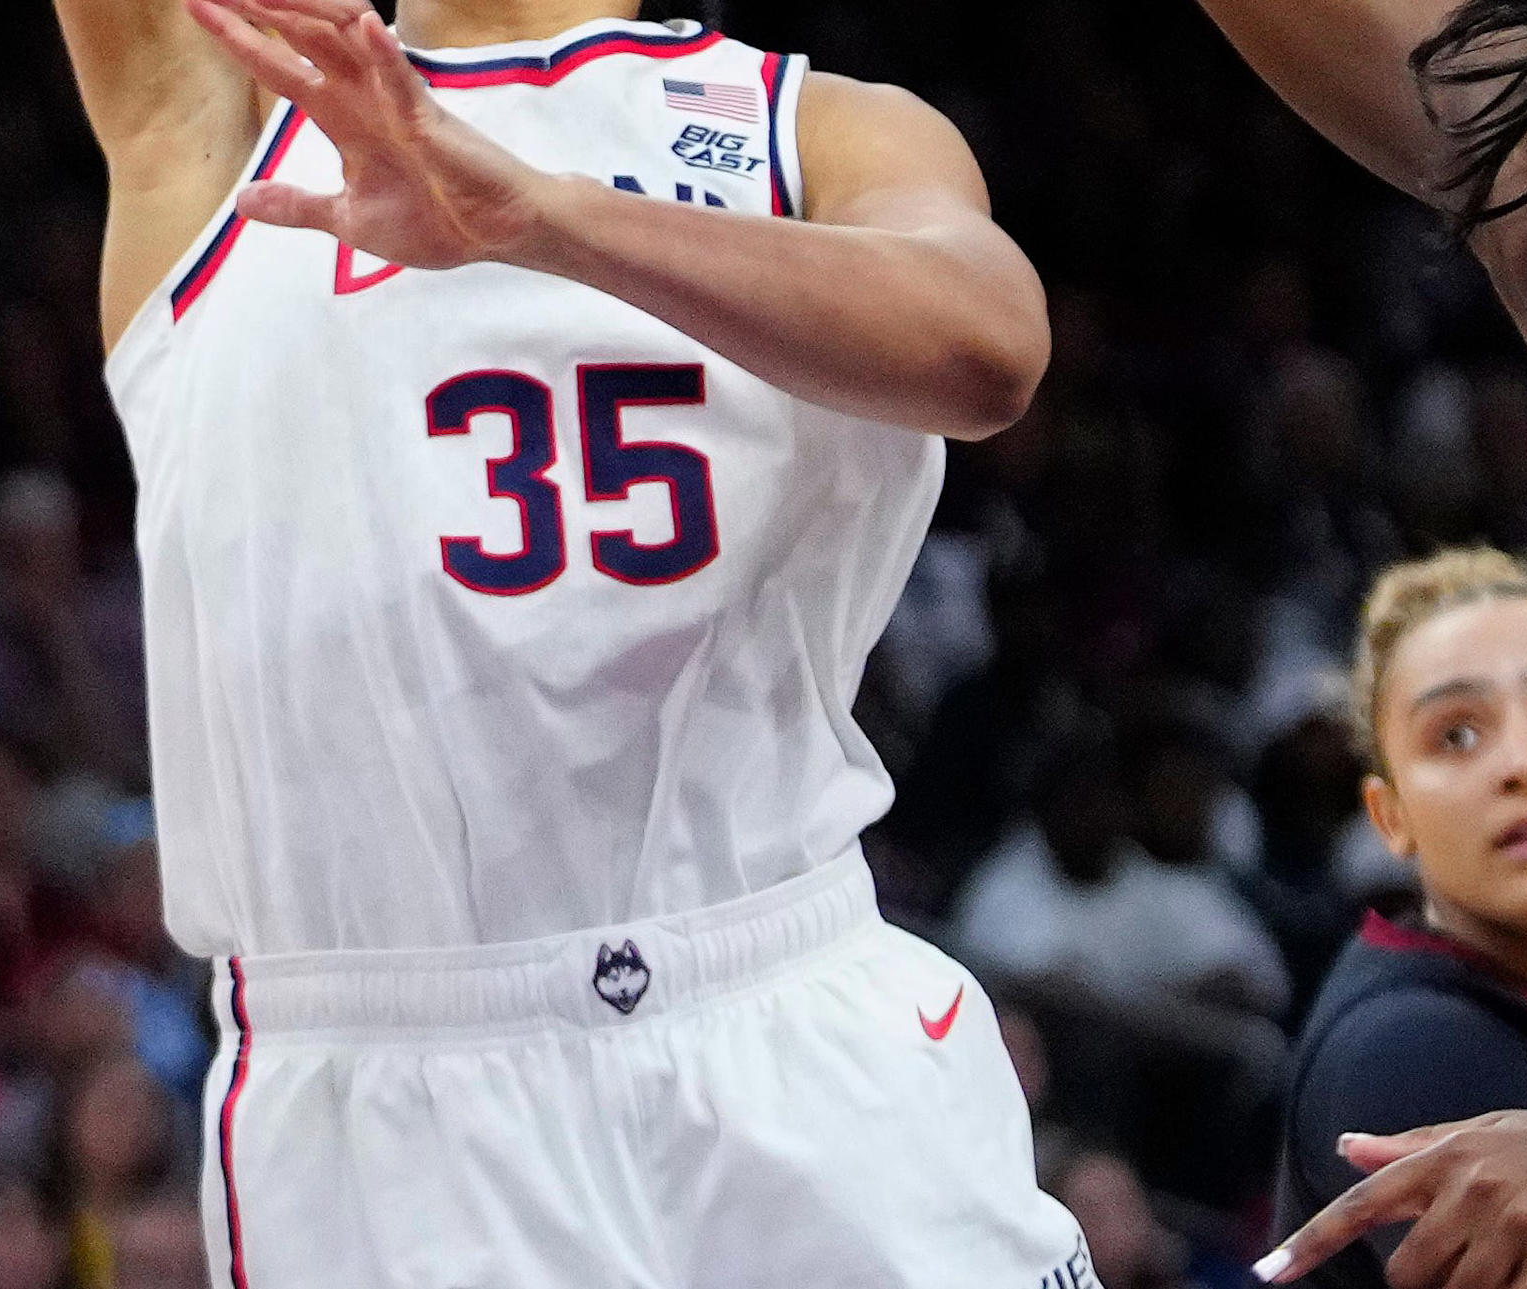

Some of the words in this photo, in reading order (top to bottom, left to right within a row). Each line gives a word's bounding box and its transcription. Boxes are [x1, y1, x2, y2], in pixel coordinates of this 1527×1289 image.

[679, 124, 750, 151] BIG
[671, 140, 766, 173] EAST
[425, 363, 720, 597] 35
